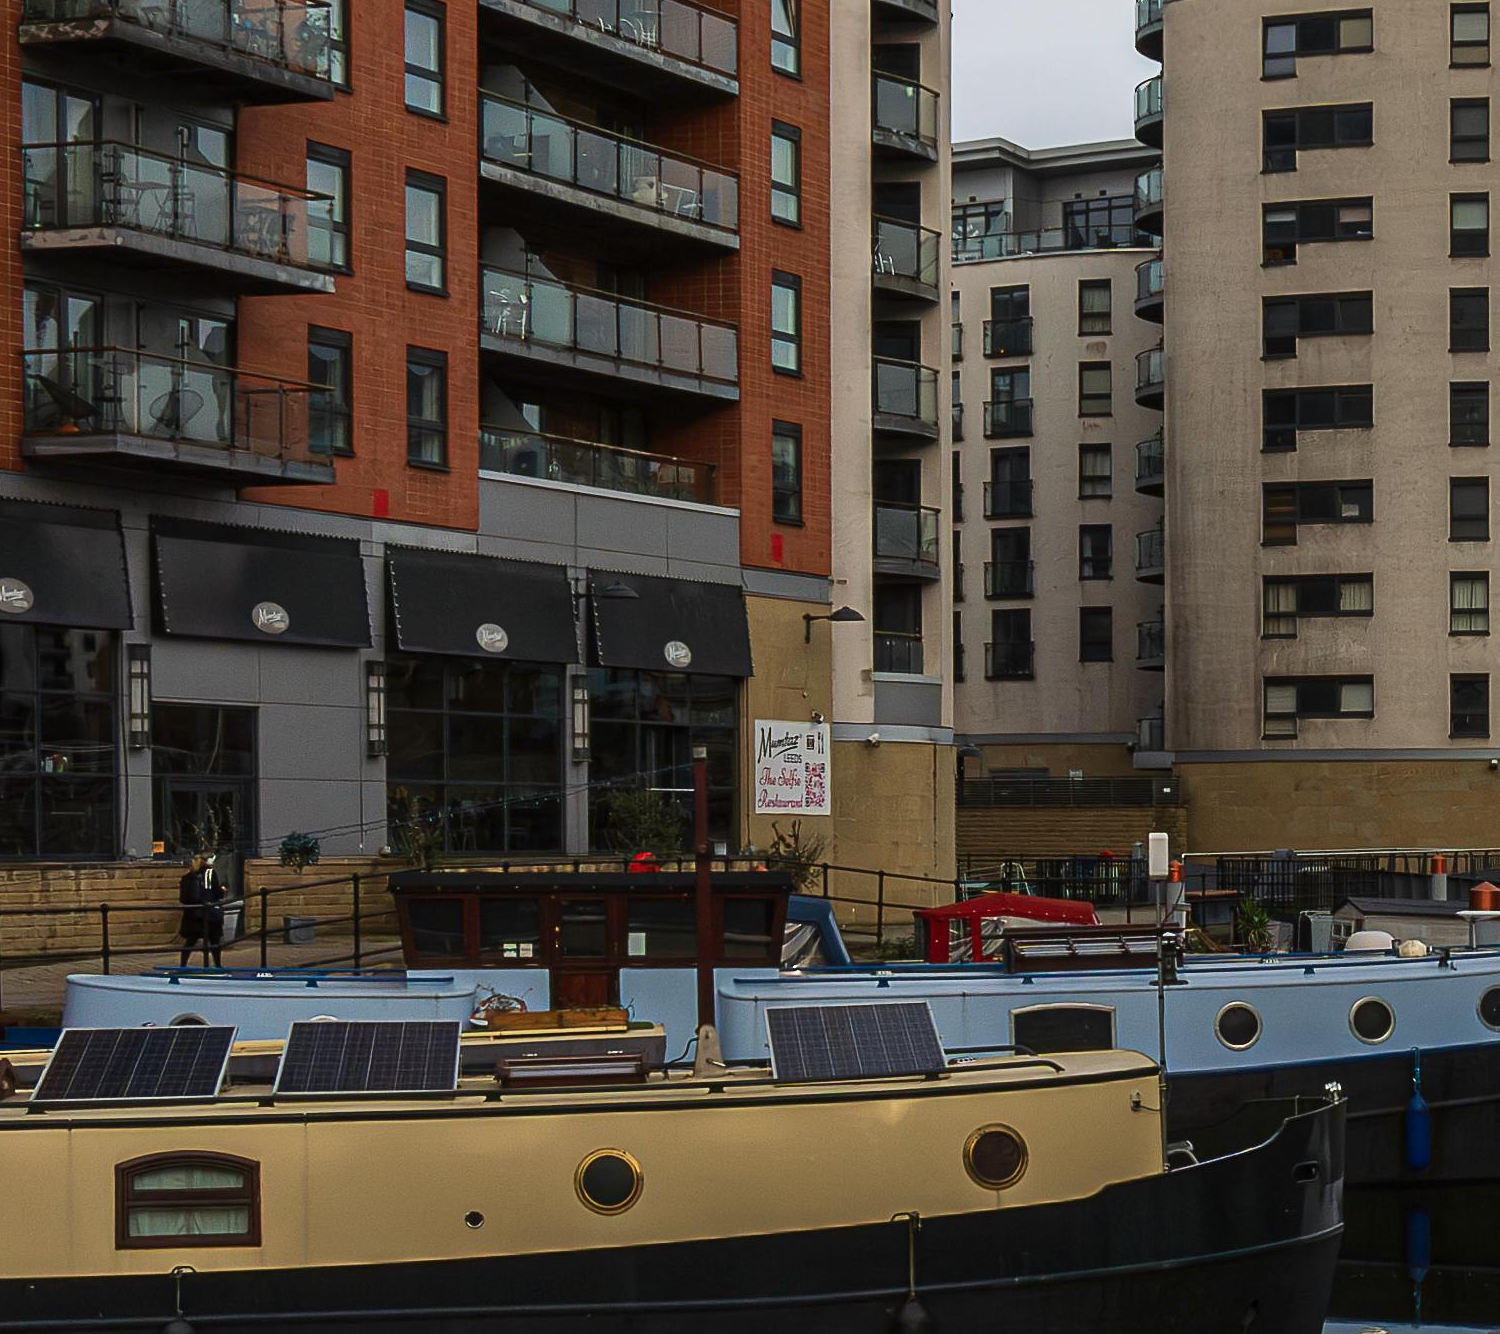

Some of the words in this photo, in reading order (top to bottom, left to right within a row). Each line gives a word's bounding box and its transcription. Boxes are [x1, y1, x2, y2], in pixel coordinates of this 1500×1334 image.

[757, 727, 801, 763] Mumtaz
[783, 753, 803, 763] LEEDS
[759, 767, 776, 786] The
[777, 768, 802, 789] Selfie
[757, 788, 804, 808] Restaurant
